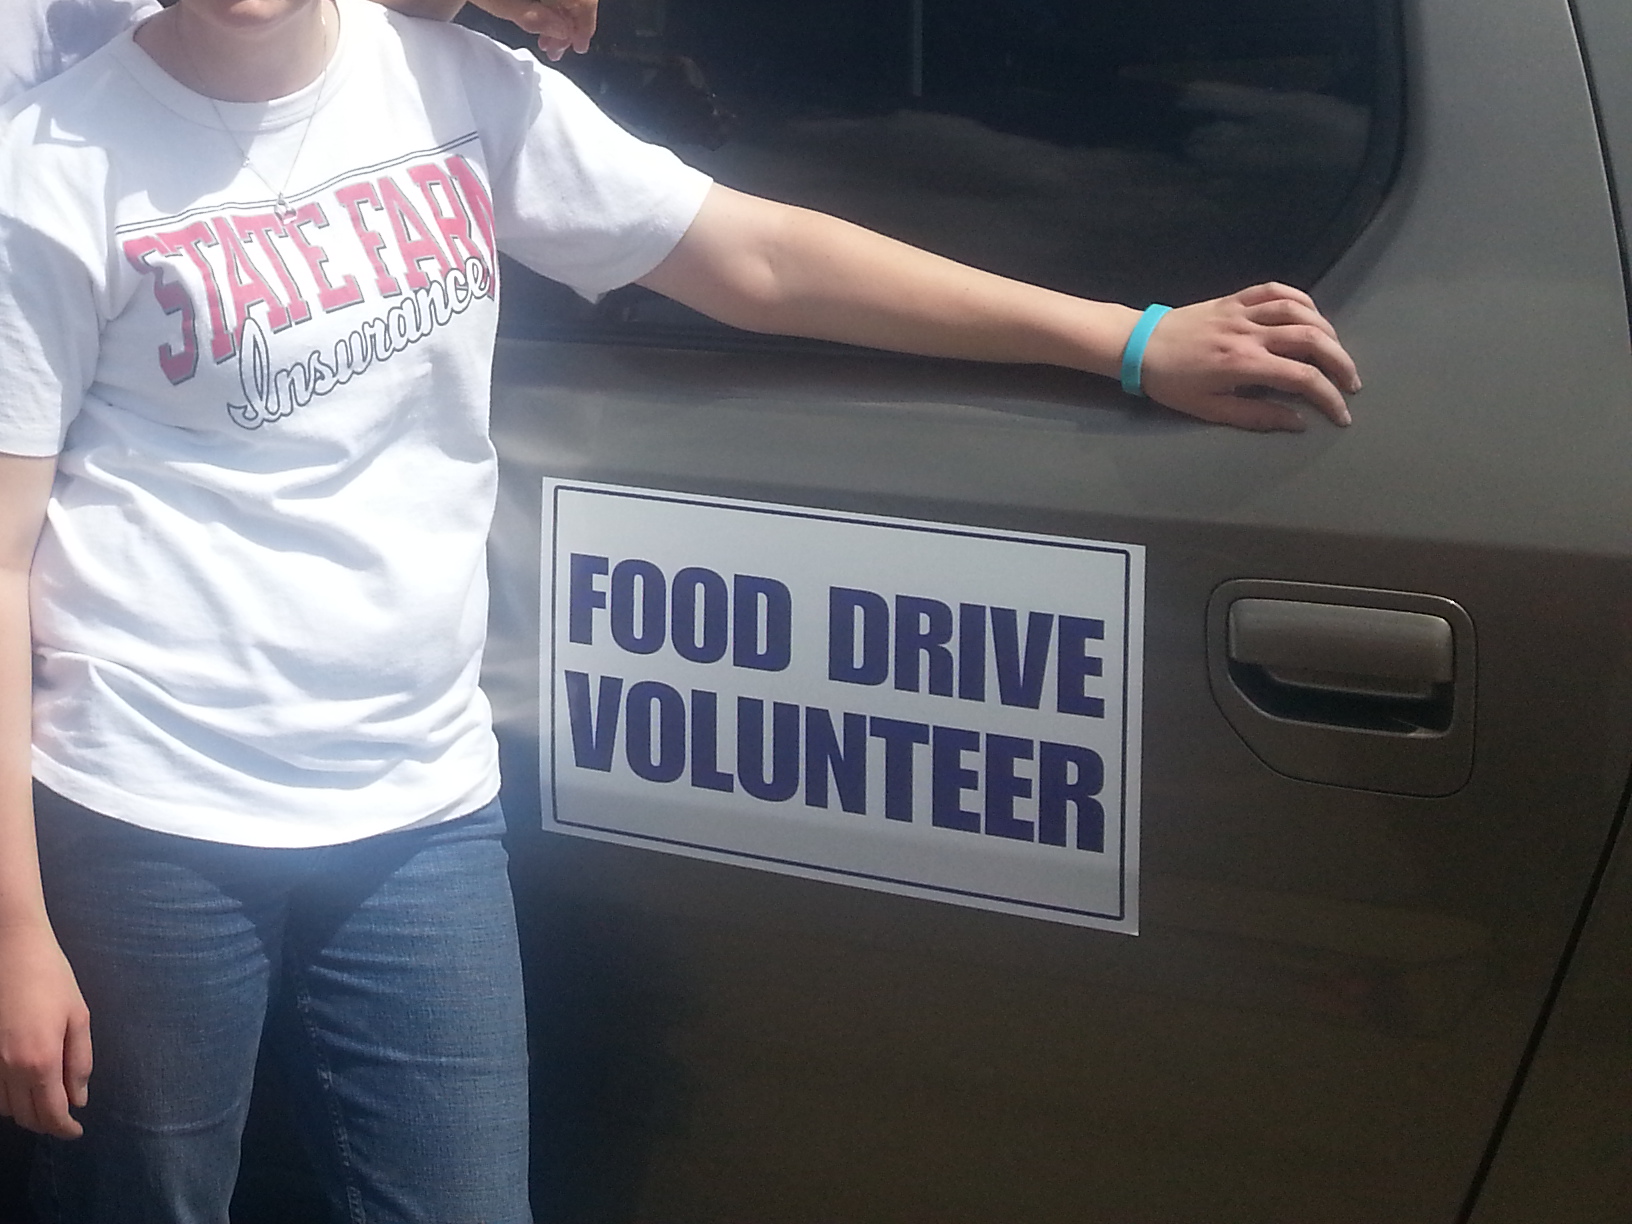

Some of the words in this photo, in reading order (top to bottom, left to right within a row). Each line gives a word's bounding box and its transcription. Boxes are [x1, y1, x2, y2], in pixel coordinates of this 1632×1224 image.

[123, 202, 364, 385] STATE
[227, 256, 491, 430] Insurance
[569, 553, 792, 672] FOOD
[828, 586, 1106, 719] DRIVE
[564, 669, 1106, 854] VOLUNTEER
